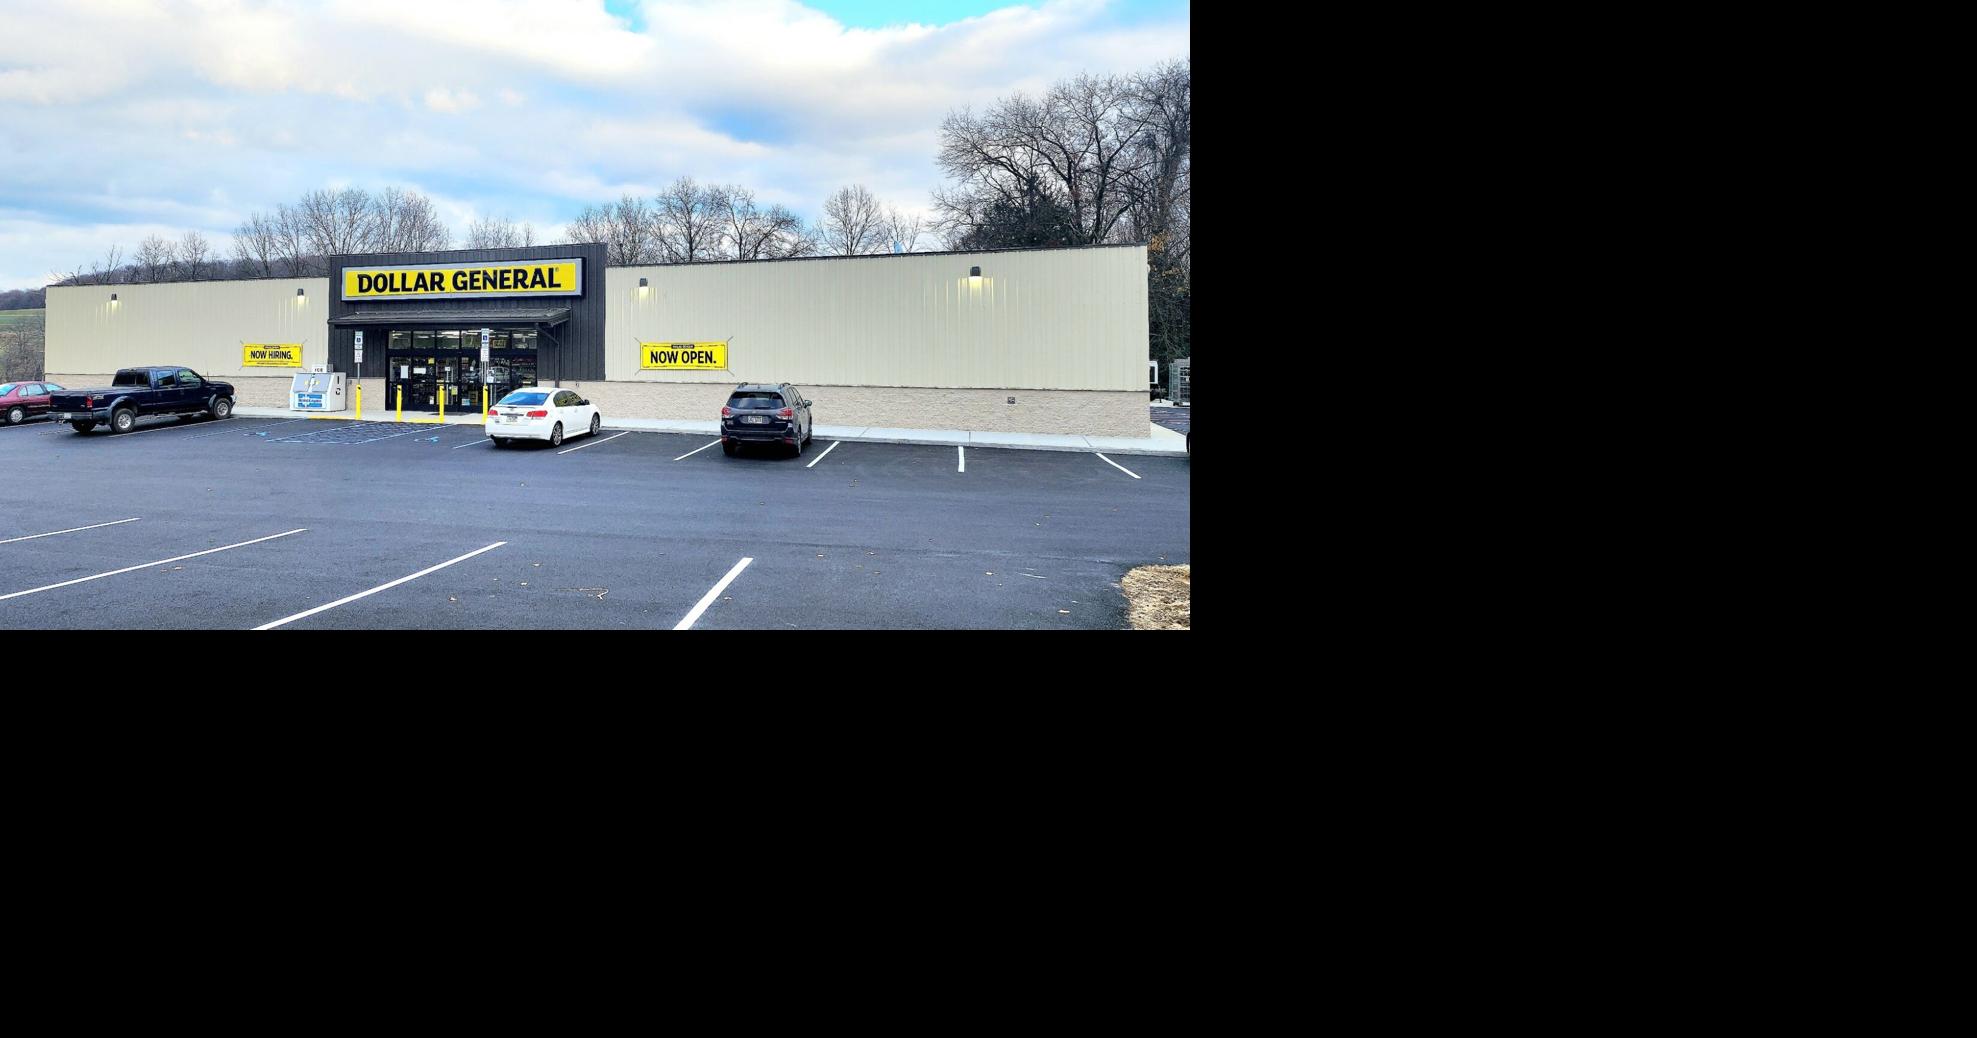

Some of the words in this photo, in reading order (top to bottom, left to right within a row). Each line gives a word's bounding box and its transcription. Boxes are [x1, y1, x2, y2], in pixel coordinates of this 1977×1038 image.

[357, 272, 445, 293] DOLLAR
[451, 267, 561, 291] GENERAL
[250, 350, 267, 359] NOW
[268, 350, 293, 360] HIRING.
[650, 351, 679, 364] NOW
[681, 350, 717, 364] OPEN.
